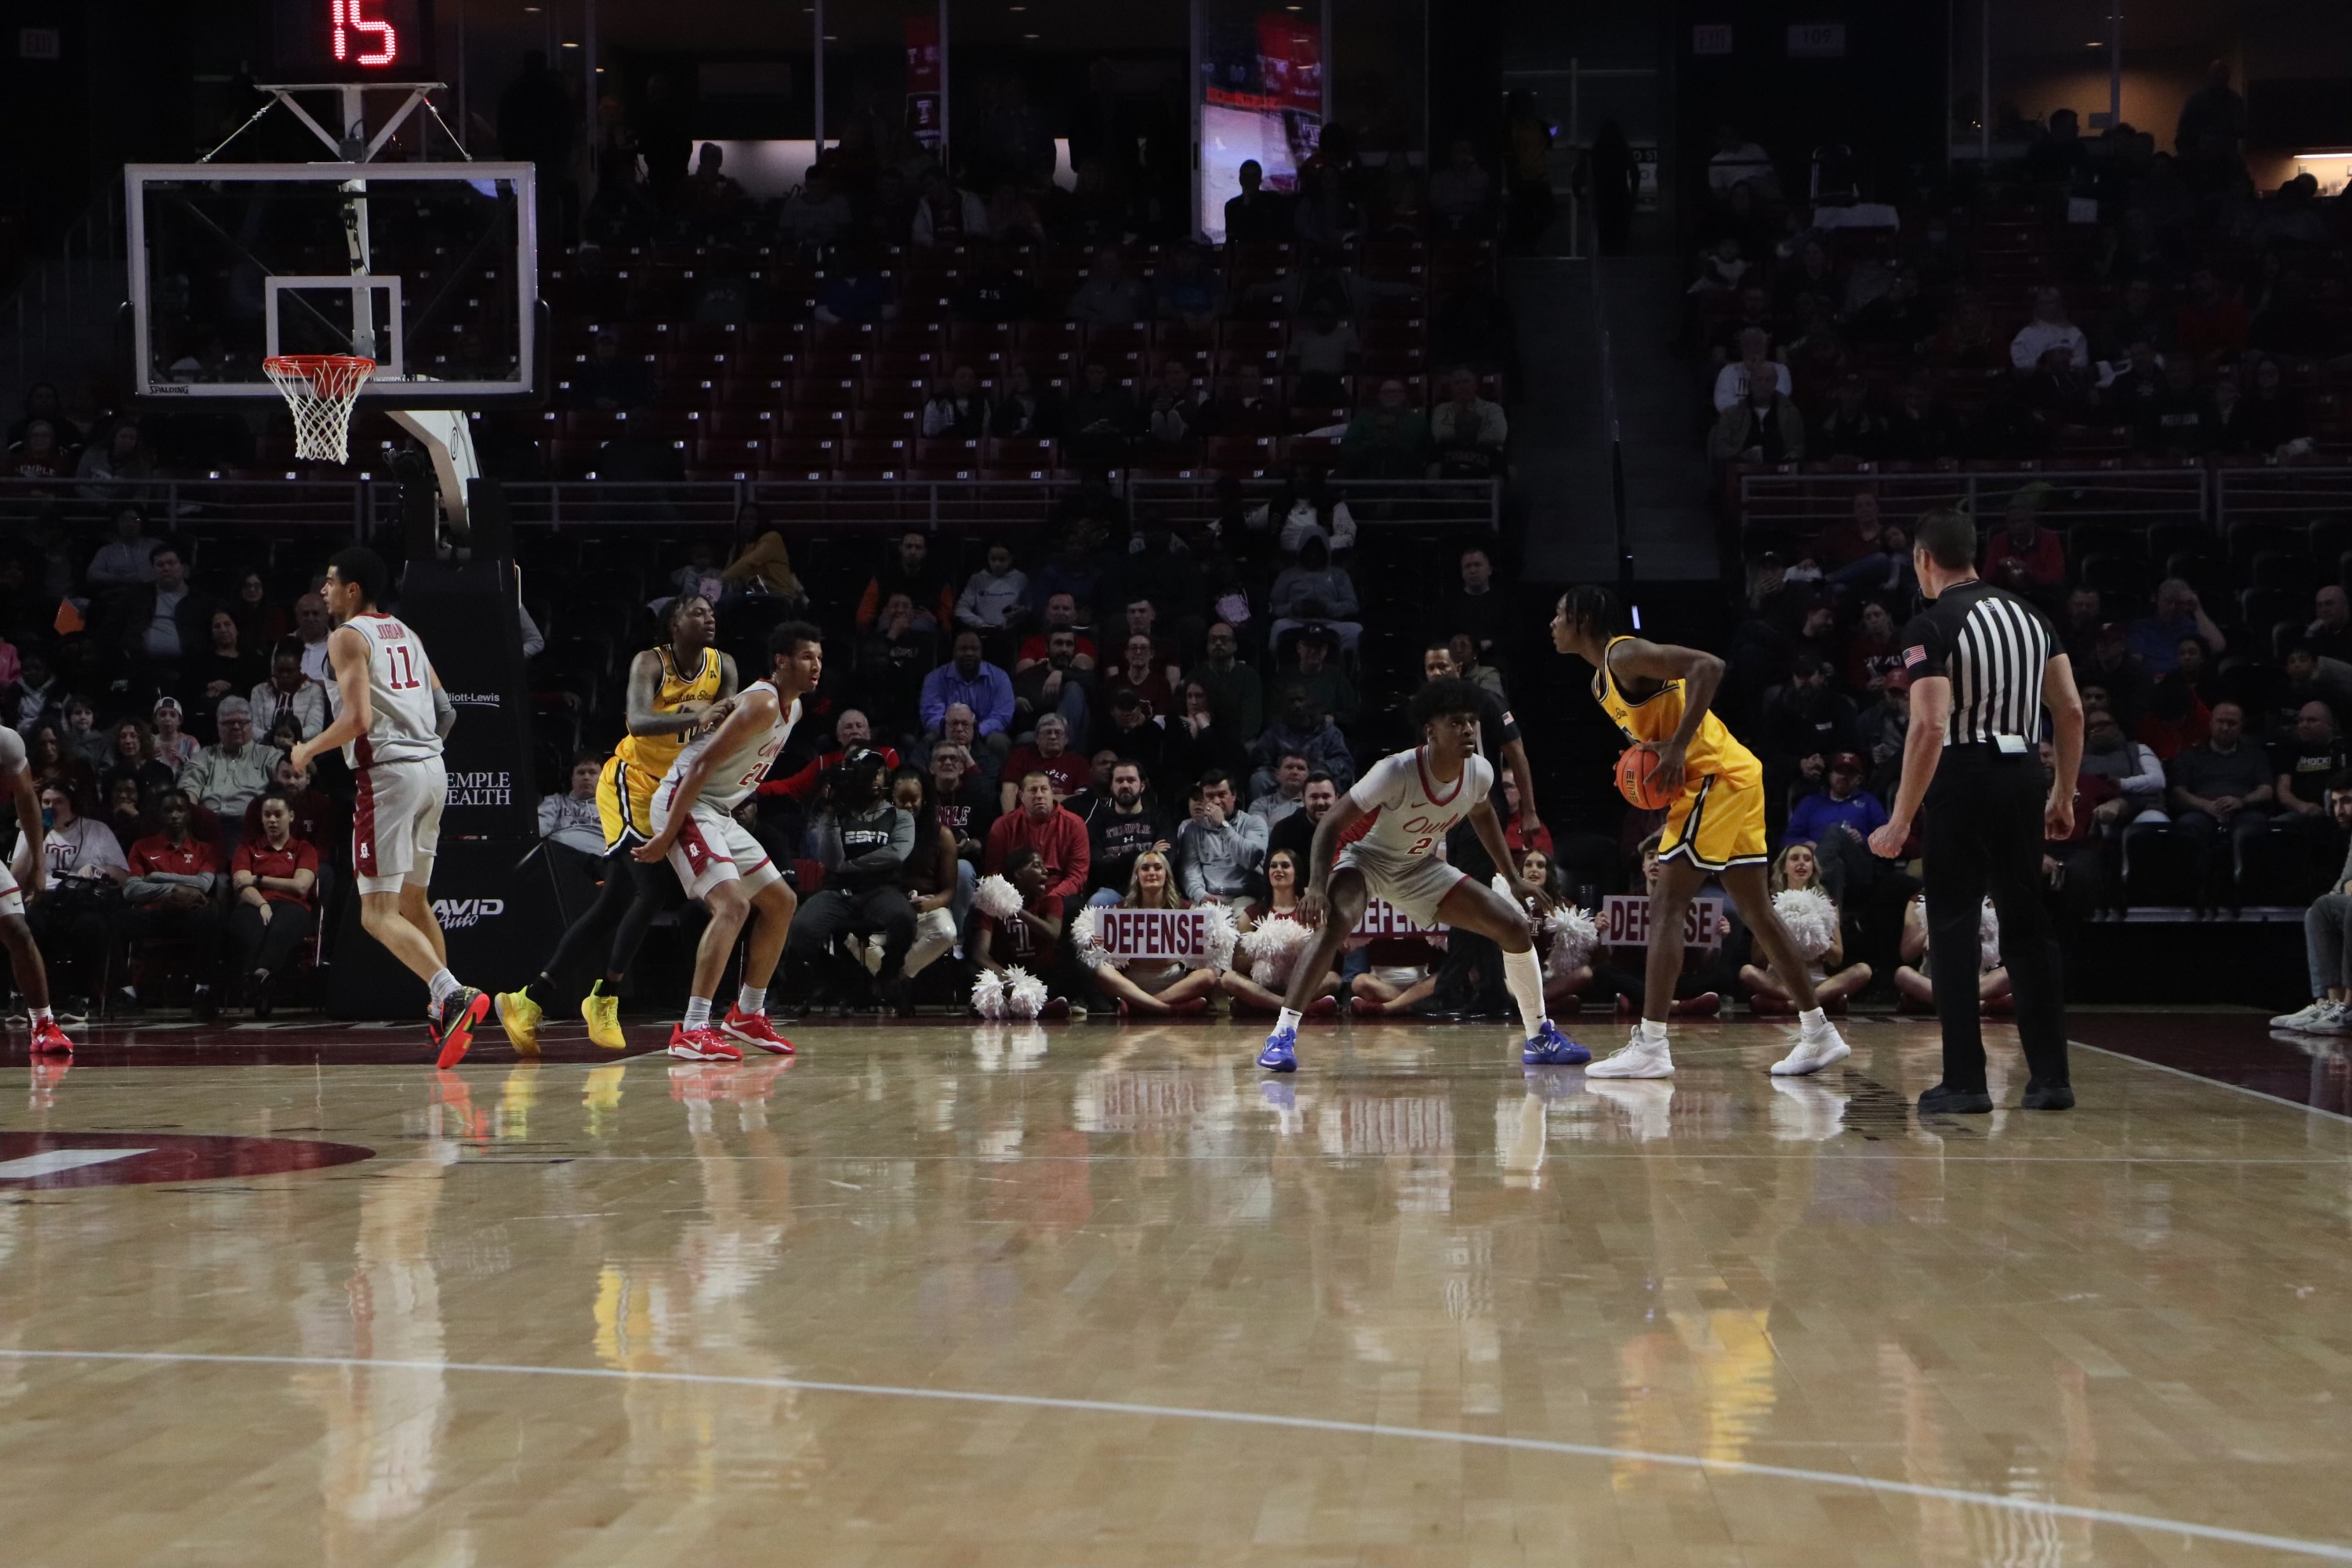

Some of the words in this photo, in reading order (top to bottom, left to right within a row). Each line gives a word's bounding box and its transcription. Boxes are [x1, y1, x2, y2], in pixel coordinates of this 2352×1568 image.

[334, 0, 396, 64] 15
[1802, 29, 1832, 44] 109
[150, 386, 189, 394] SPALDING
[386, 645, 421, 690] 11
[447, 692, 500, 702] lliott-Lewis
[446, 772, 510, 788] EMPLE
[446, 789, 511, 805] EALTH
[845, 831, 889, 844] ESPN
[1408, 837, 1432, 855] 2
[431, 899, 504, 916] AVID
[438, 912, 479, 930] Auto
[1610, 901, 1713, 943] DEFSE
[1104, 913, 1204, 955] DEFENSE
